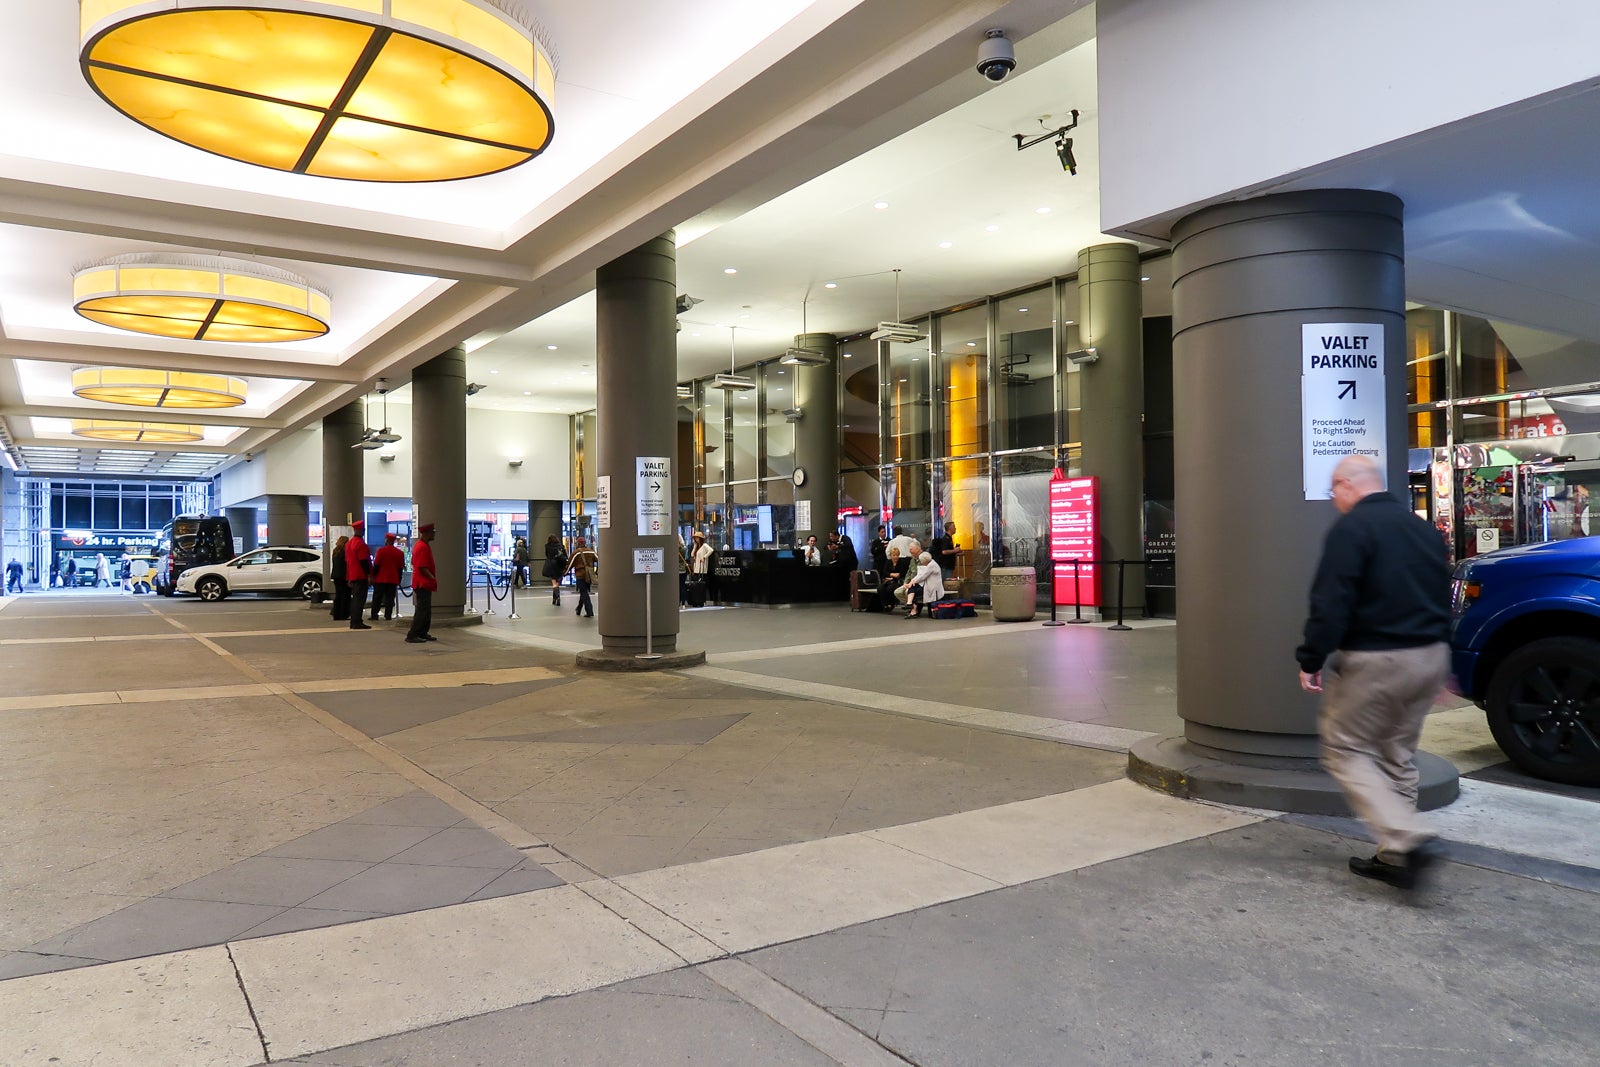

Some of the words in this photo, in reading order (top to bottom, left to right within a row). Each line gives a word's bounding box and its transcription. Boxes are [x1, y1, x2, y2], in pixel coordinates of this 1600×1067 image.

[1321, 336, 1369, 350] VALET
[1311, 354, 1377, 369] PARKING
[1312, 418, 1343, 426] Proceed
[1343, 418, 1365, 426] Ahead
[1313, 427, 1322, 435] To
[1323, 427, 1343, 437] Right
[1344, 426, 1367, 436] Slowly
[1328, 439, 1356, 447] Caution
[1312, 448, 1352, 456] Pedestrian
[1353, 447, 1379, 457] Crossing
[644, 462, 665, 470] VALET
[86, 537, 100, 546] 24
[102, 536, 116, 546] hr.
[117, 536, 159, 547] Parking
[718, 556, 737, 566] GUEST
[714, 567, 741, 577] SERVICES
